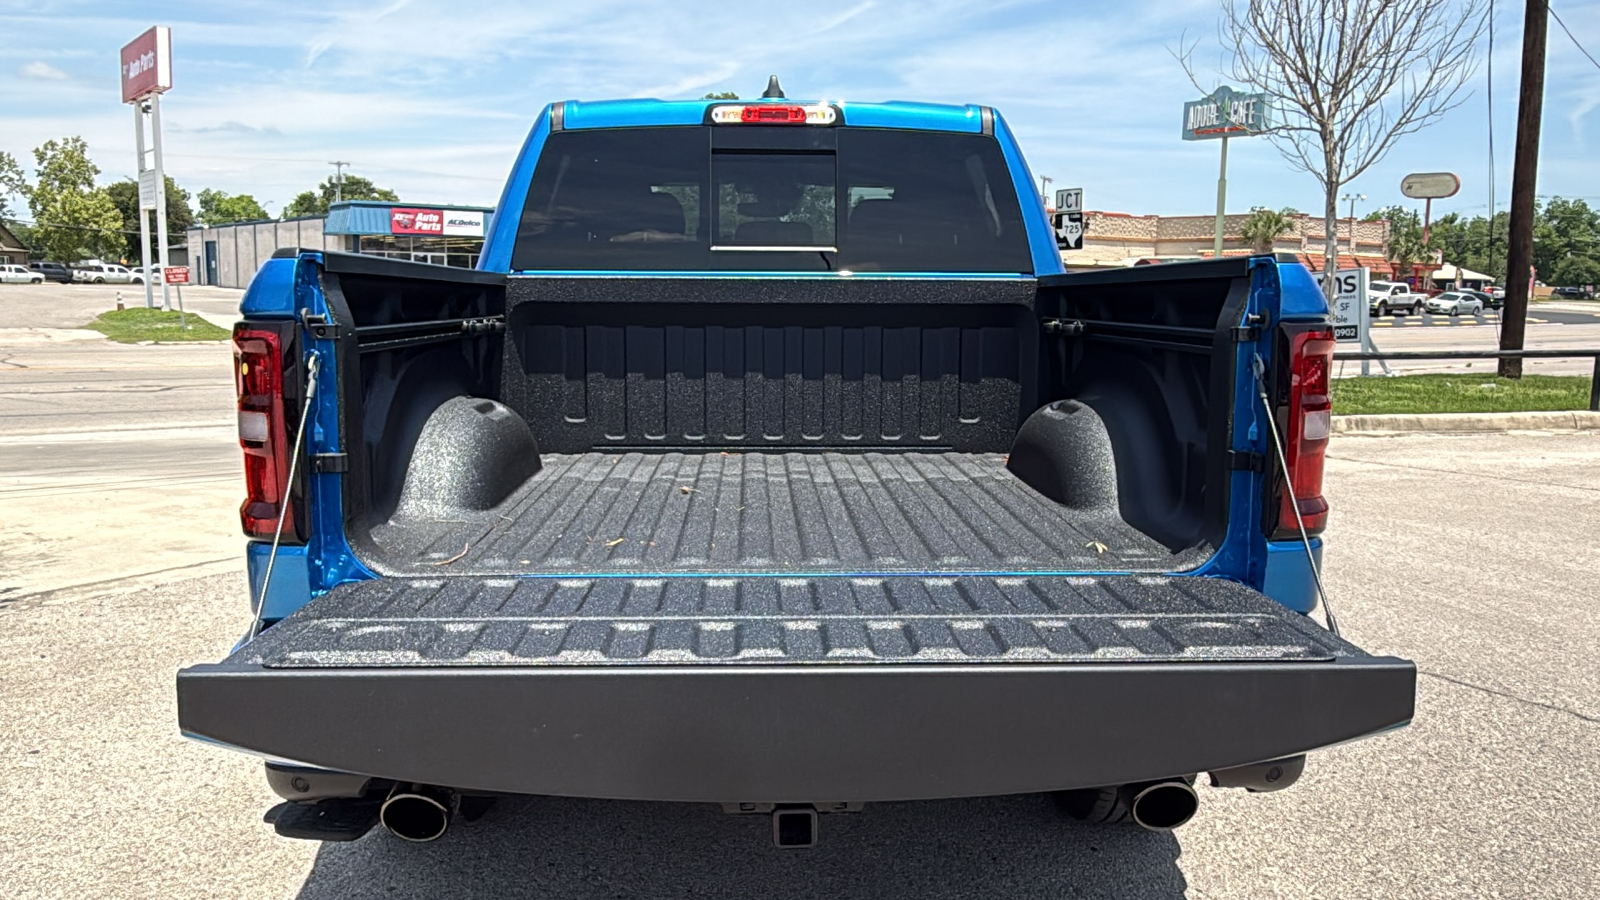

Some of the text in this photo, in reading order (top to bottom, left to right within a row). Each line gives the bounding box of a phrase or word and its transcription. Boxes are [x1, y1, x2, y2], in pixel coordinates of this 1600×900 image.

[1187, 103, 1220, 130] ADOBE
[1057, 192, 1080, 209] JCT
[415, 212, 439, 222] Auto
[414, 221, 441, 231] Parts
[447, 219, 480, 227] ACDelco
[1064, 224, 1080, 234] 725
[1340, 302, 1350, 311] SF
